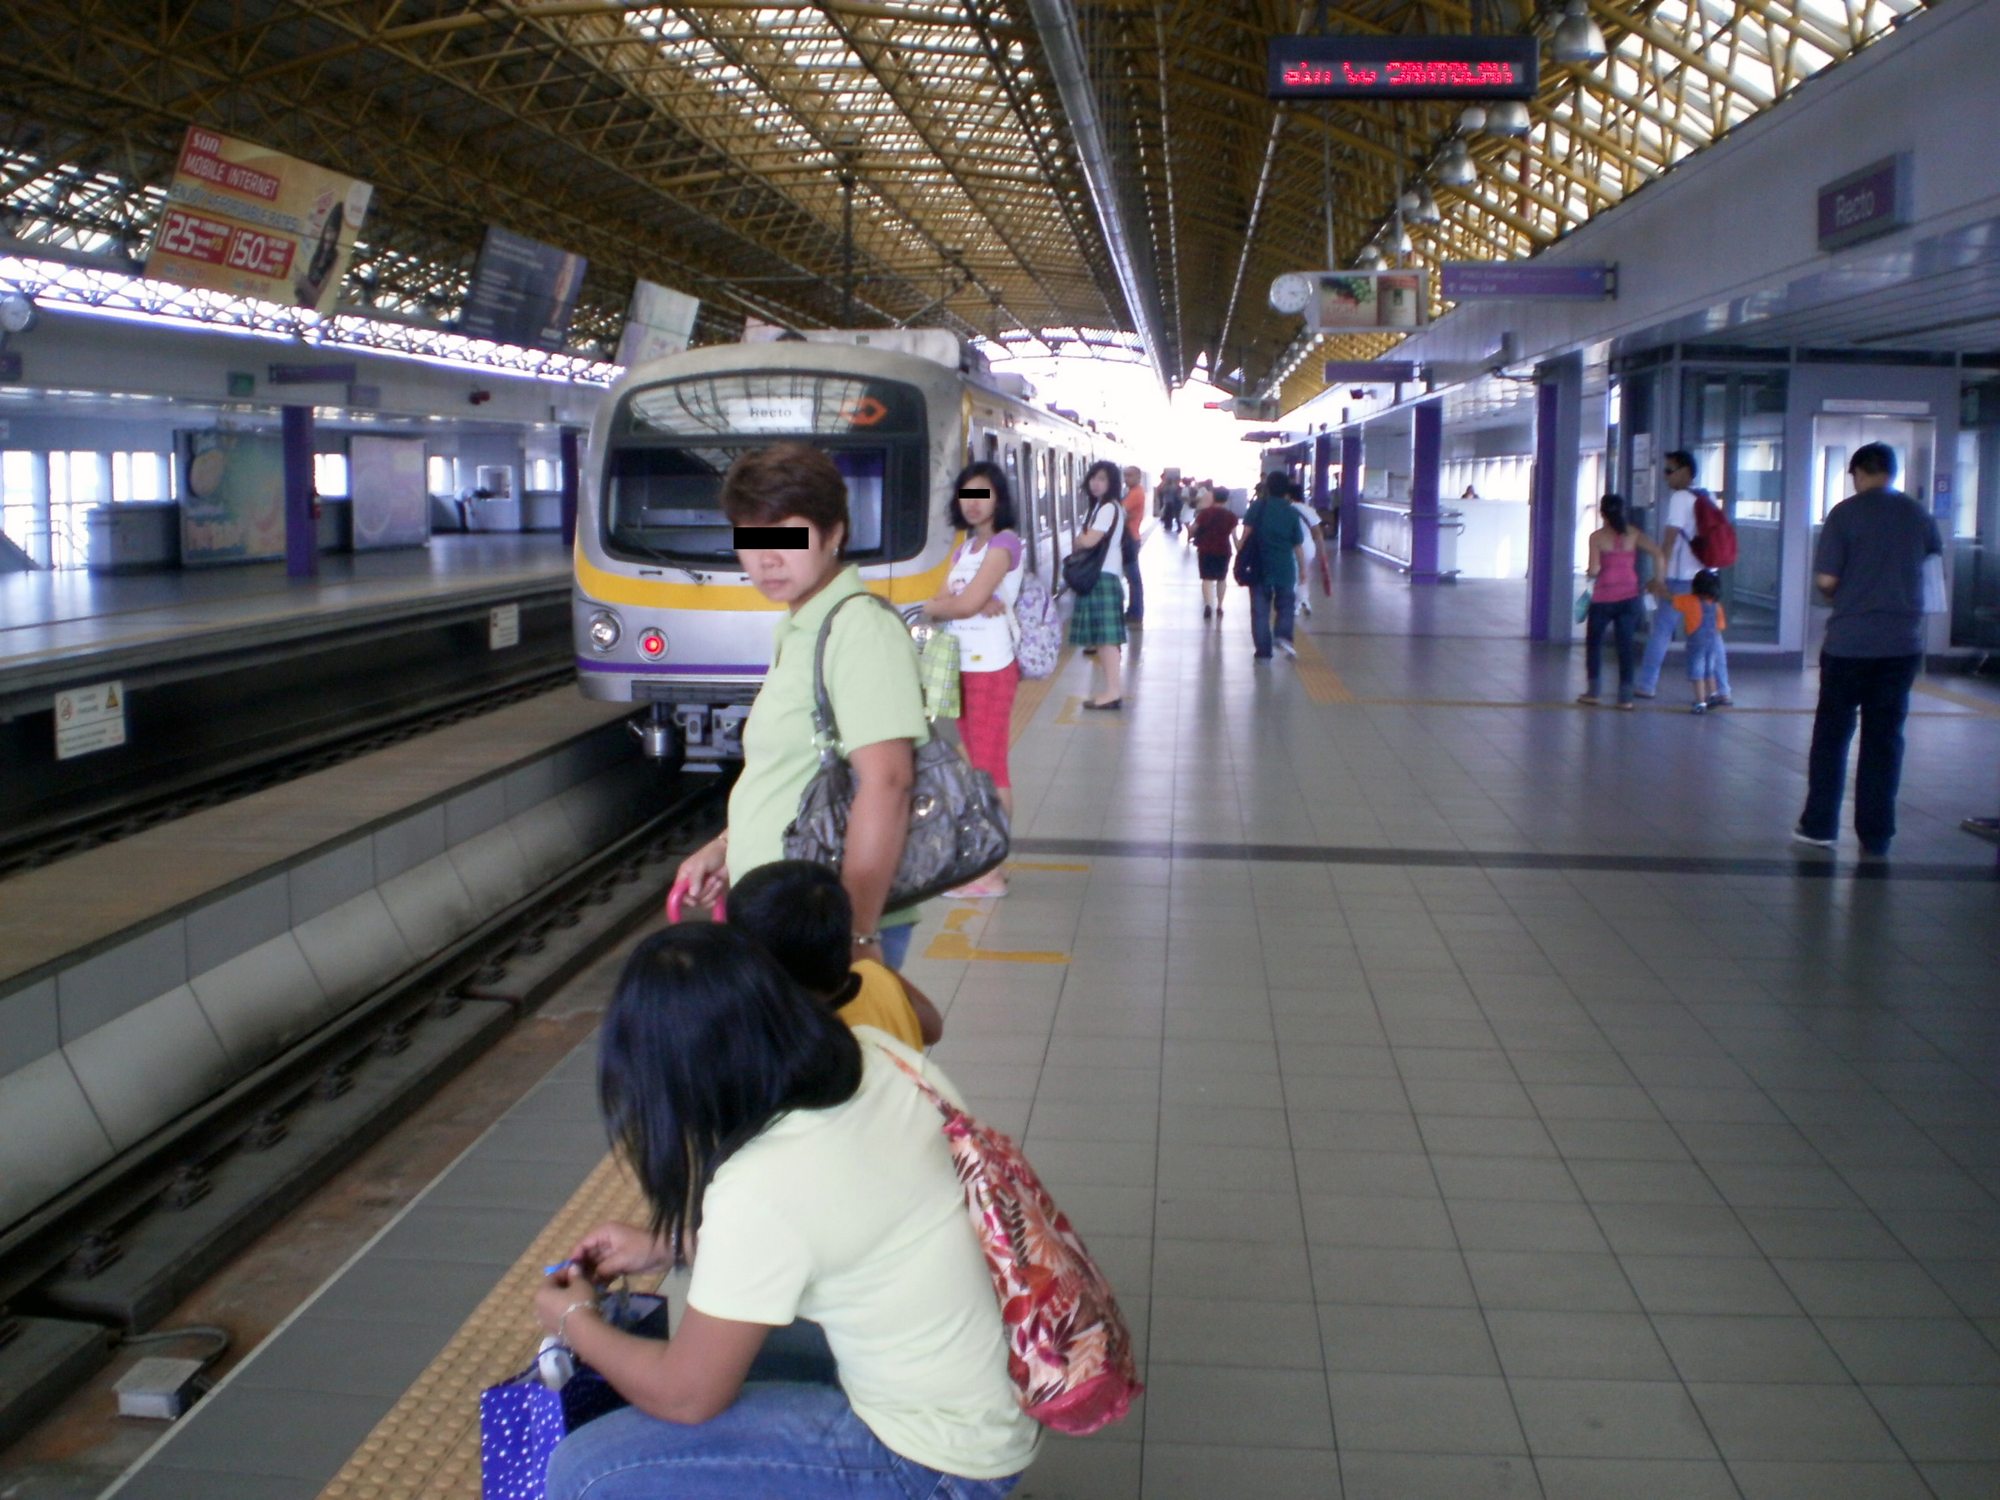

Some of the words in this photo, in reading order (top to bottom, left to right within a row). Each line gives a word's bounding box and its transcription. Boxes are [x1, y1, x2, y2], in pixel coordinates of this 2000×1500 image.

[183, 153, 227, 182] MOBILE
[227, 167, 278, 197] INTERNET
[750, 407, 792, 418] Recto
